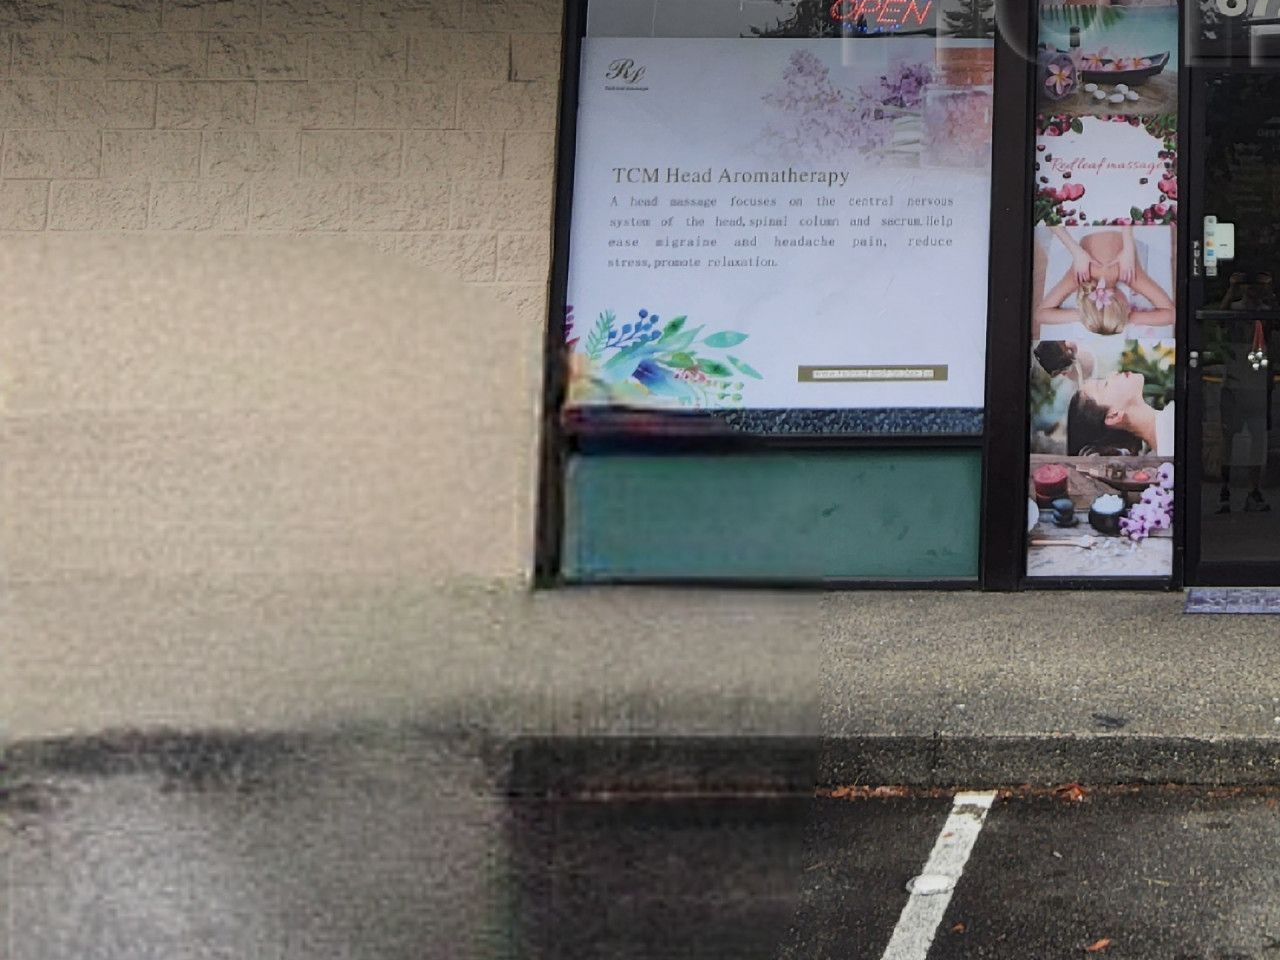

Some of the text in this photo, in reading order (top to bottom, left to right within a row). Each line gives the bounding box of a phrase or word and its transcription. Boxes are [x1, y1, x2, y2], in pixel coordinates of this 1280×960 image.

[1106, 160, 1163, 175] massage
[612, 167, 850, 187] TCM Head Aromatherapy
[610, 196, 954, 209] A head massage focuses on the central nervous
[610, 216, 649, 228] system
[661, 216, 674, 227] of
[686, 216, 704, 227] the
[850, 216, 870, 227] and
[608, 238, 639, 248] ease
[655, 236, 717, 249] migraine
[734, 236, 757, 247] and
[774, 236, 835, 247] headache
[908, 236, 953, 247] reduce
